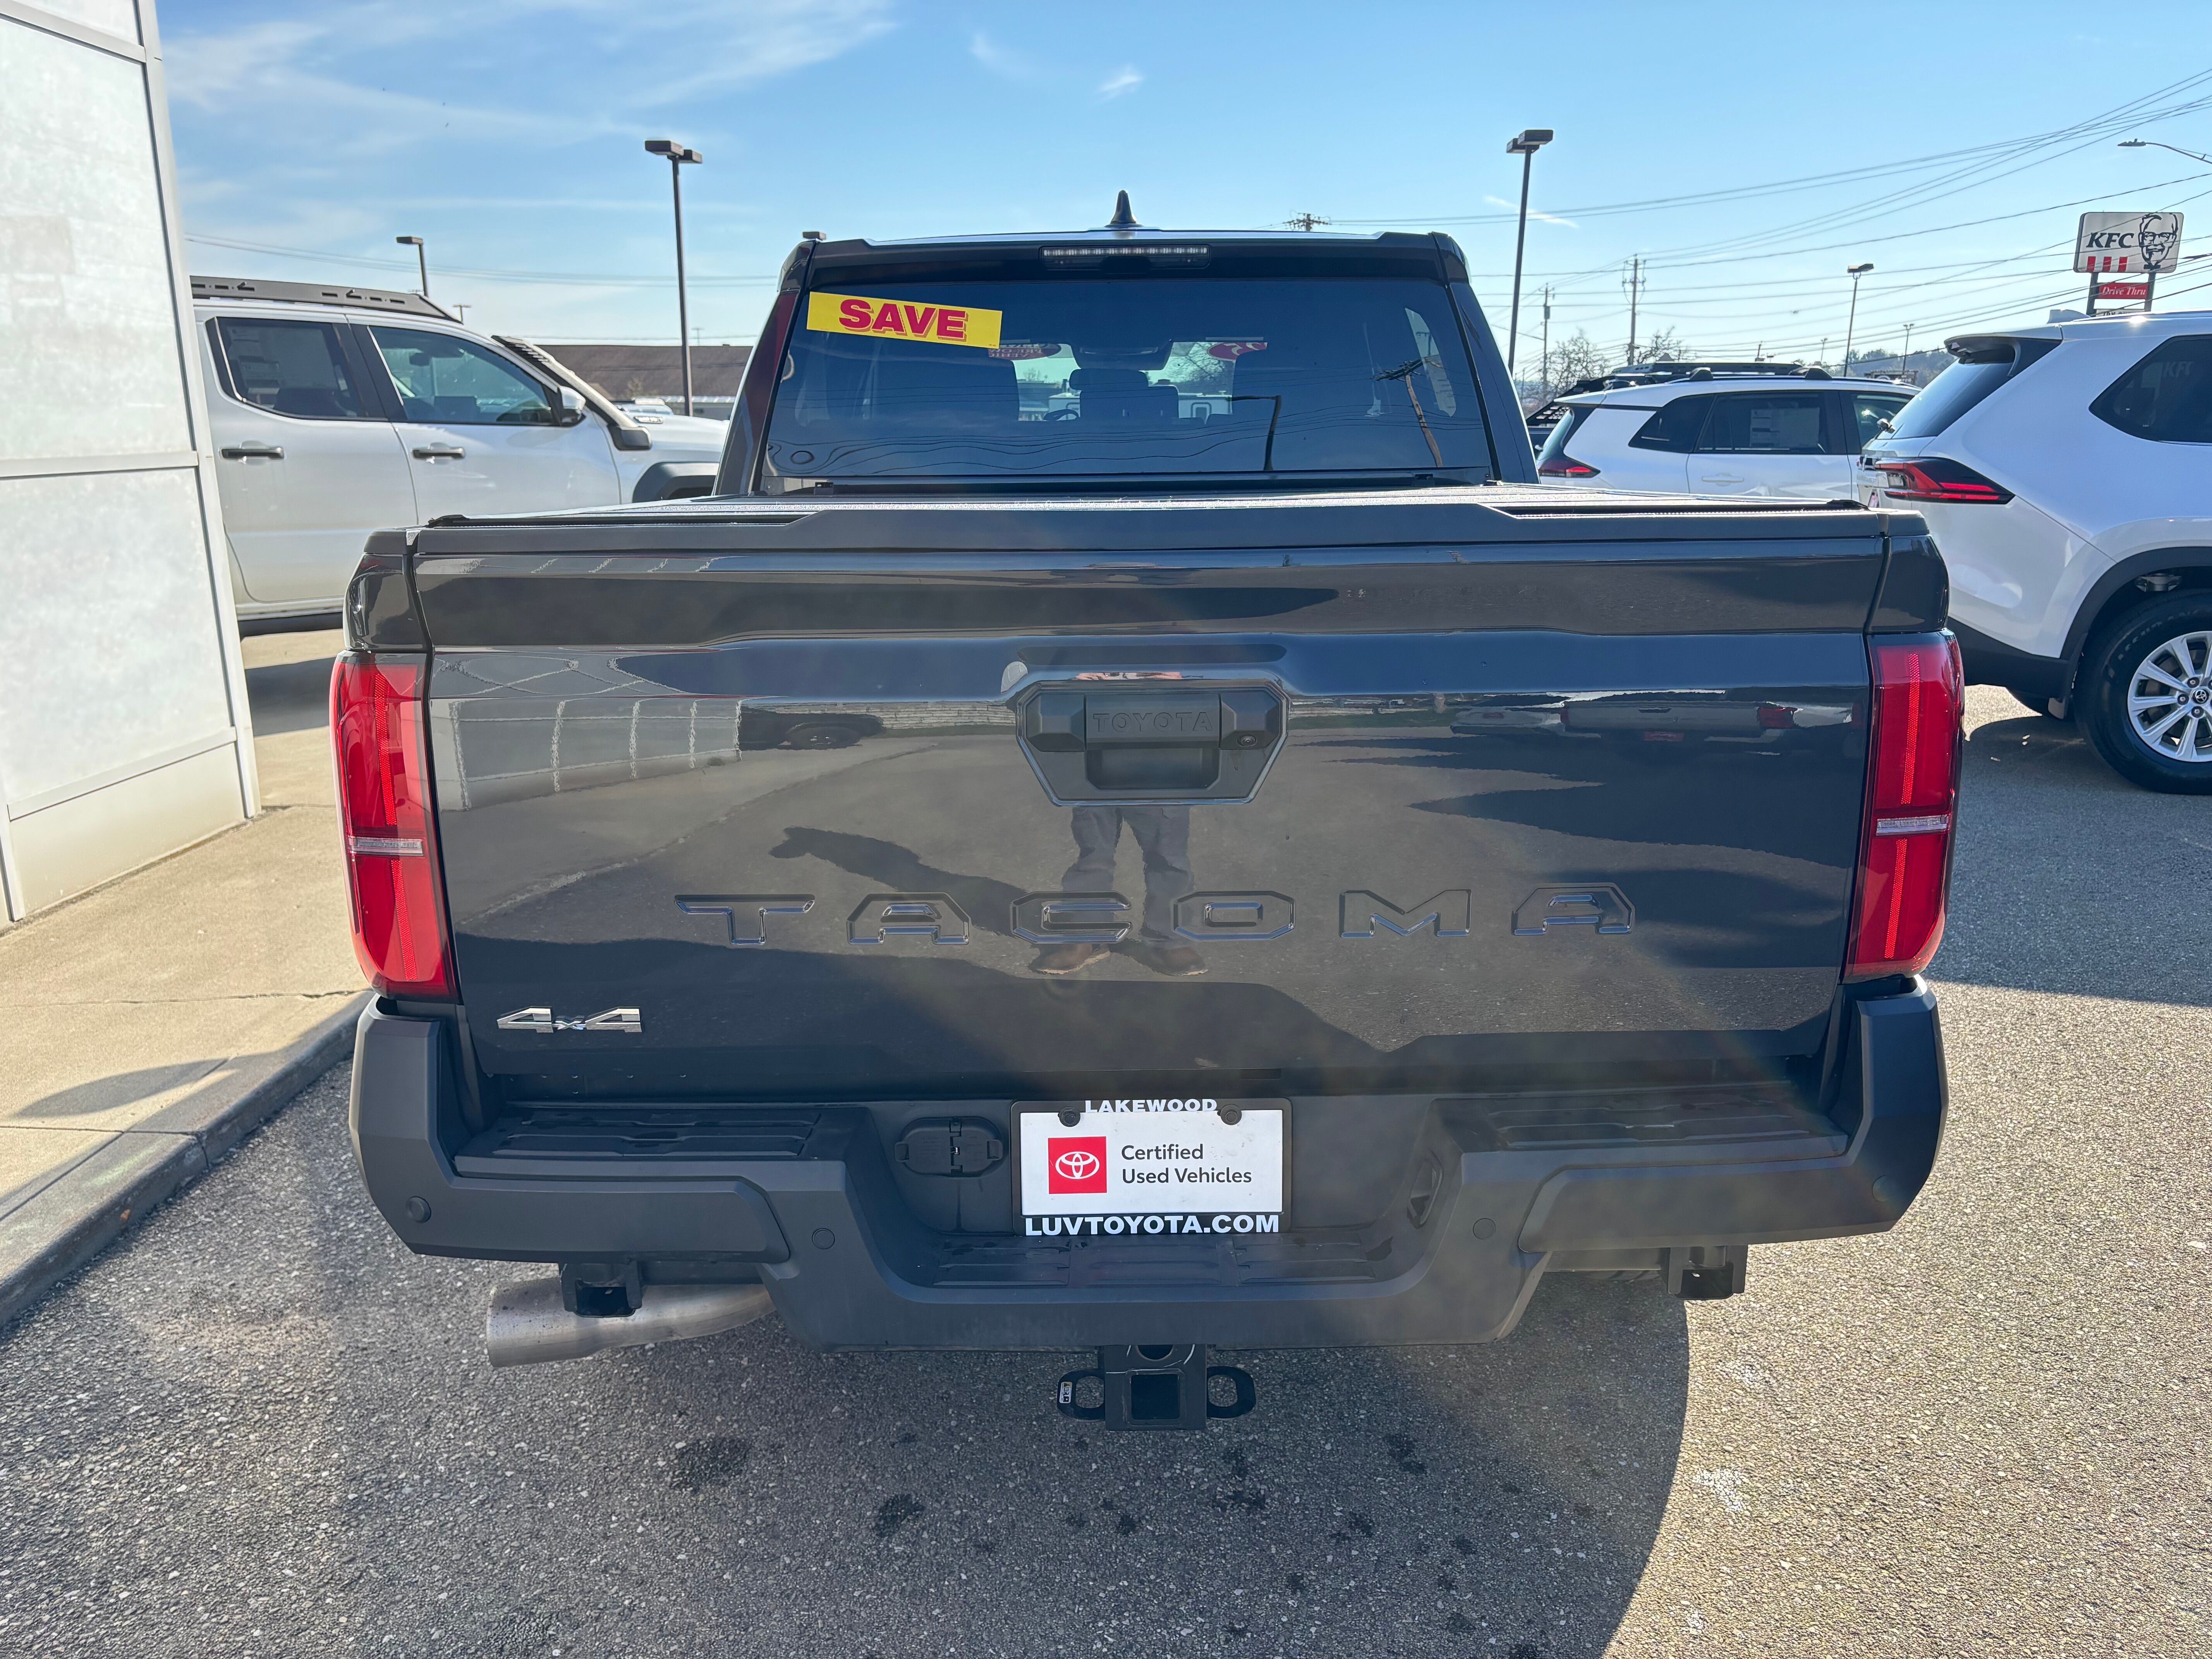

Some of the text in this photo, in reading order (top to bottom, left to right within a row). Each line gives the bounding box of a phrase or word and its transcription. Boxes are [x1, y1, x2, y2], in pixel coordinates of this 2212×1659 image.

[2086, 232, 2134, 249] KFC
[2102, 287, 2146, 295] Drive Thru
[839, 299, 968, 342] SAVE
[1093, 711, 1212, 733] TOYOTA
[674, 882, 1635, 946] TACOMA
[1085, 1098, 1218, 1113] LAKEWOOD
[1121, 1144, 1204, 1160] Certified
[1123, 1167, 1252, 1183] Used Vehicles
[1025, 1214, 1279, 1236] LUVTOYOTA.COM
